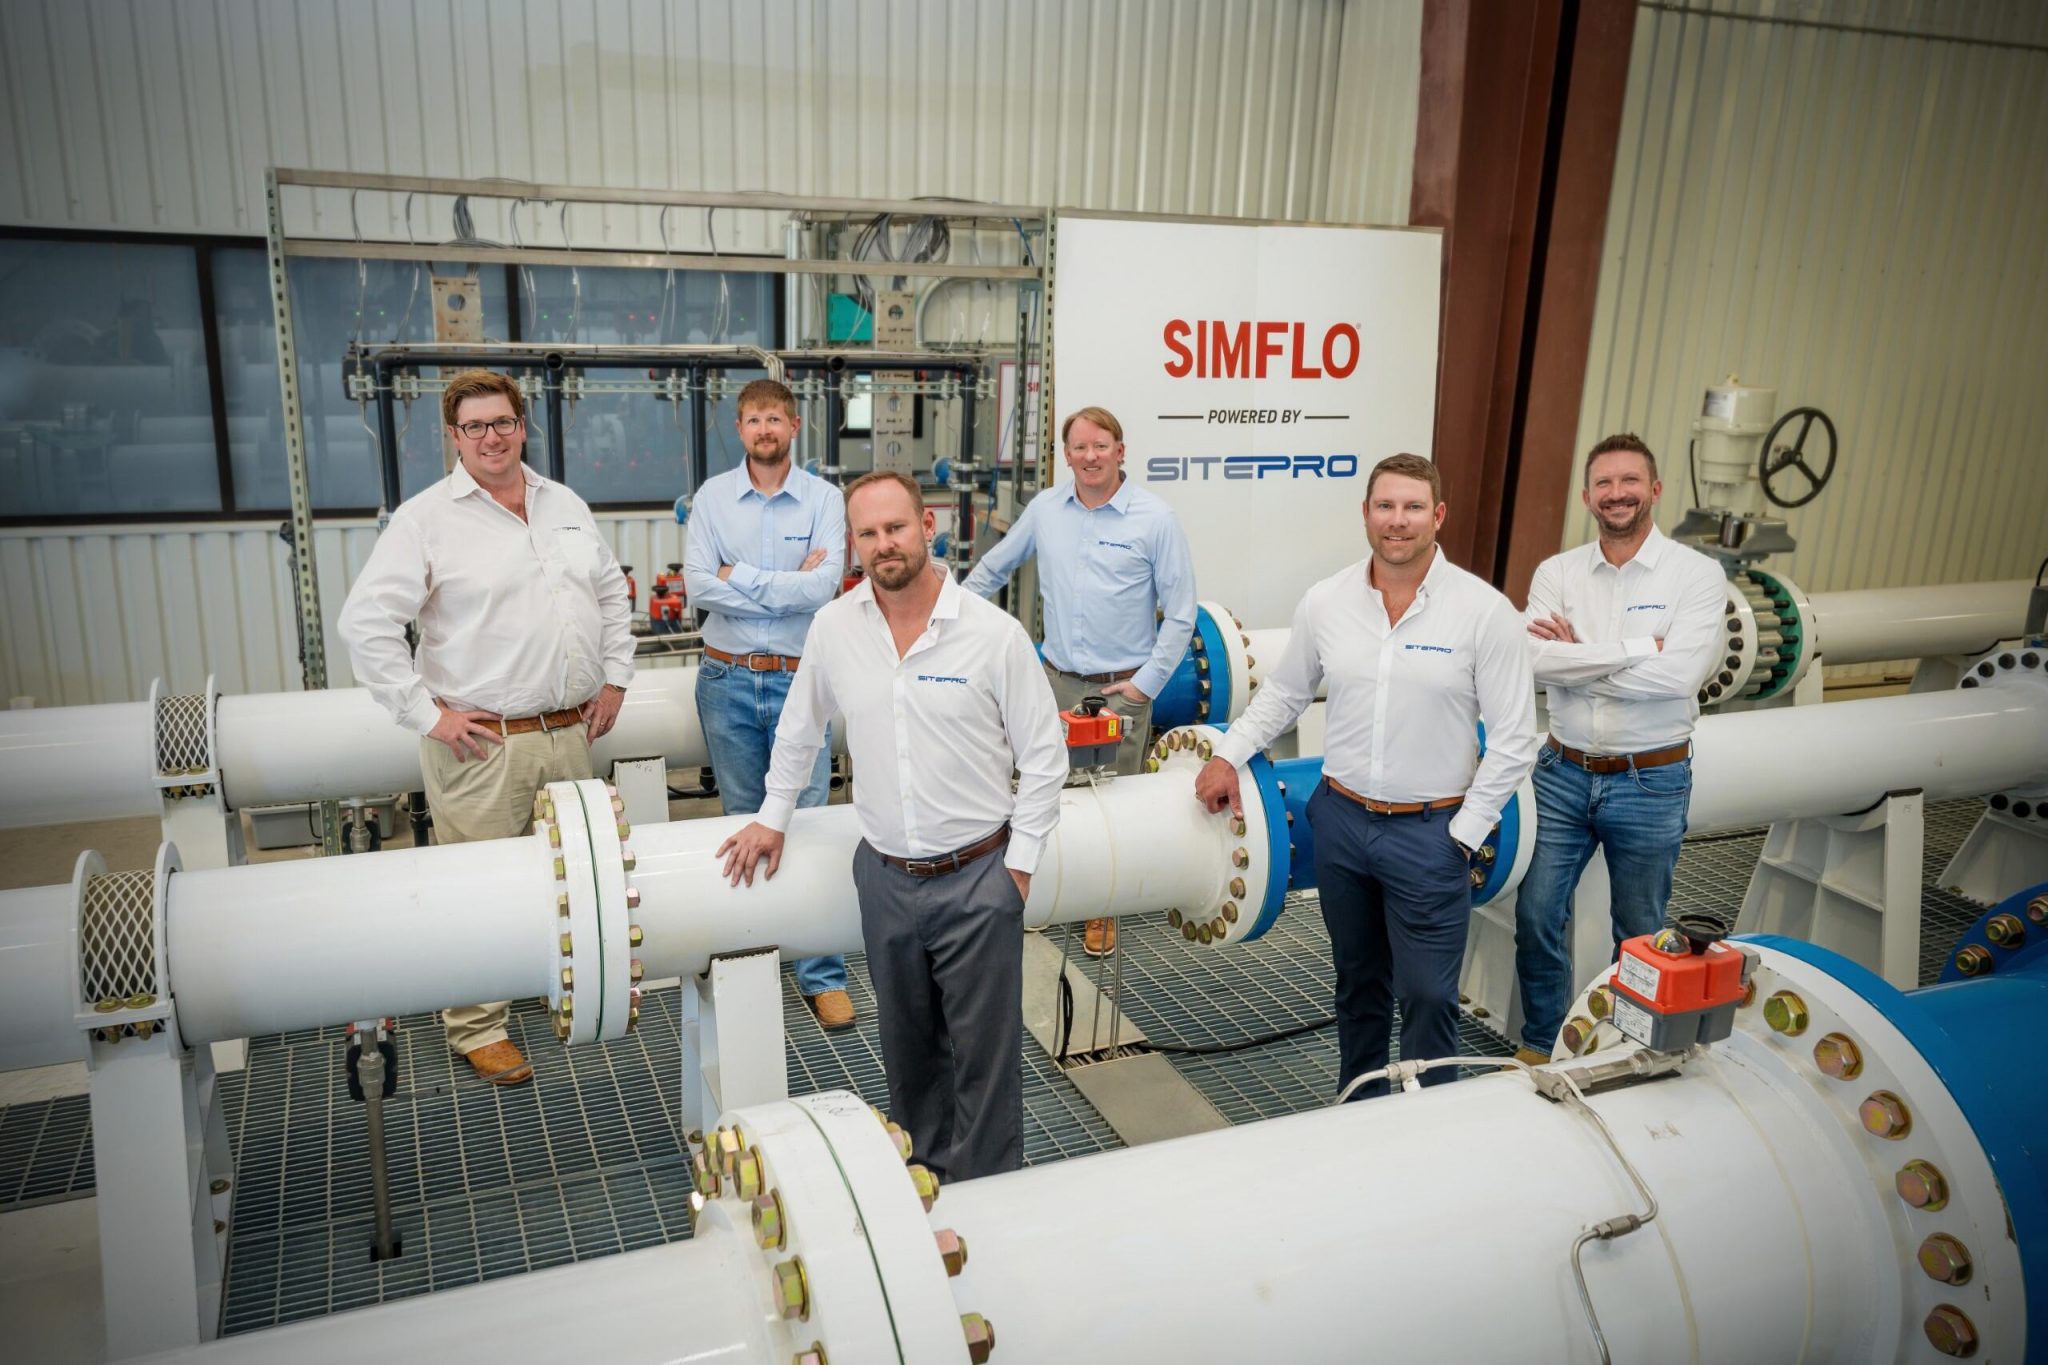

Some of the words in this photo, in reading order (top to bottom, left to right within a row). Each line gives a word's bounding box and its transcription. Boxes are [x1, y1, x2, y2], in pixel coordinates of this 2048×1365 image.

[1163, 318, 1361, 380] SIMFLO
[1207, 409, 1278, 424] POWERED
[1281, 409, 1302, 424] BY
[1146, 454, 1359, 482] SITEPRO
[1098, 540, 1132, 550] SITEPRO
[1404, 644, 1453, 654] SITEPRO
[917, 675, 968, 684] SITEPRO
